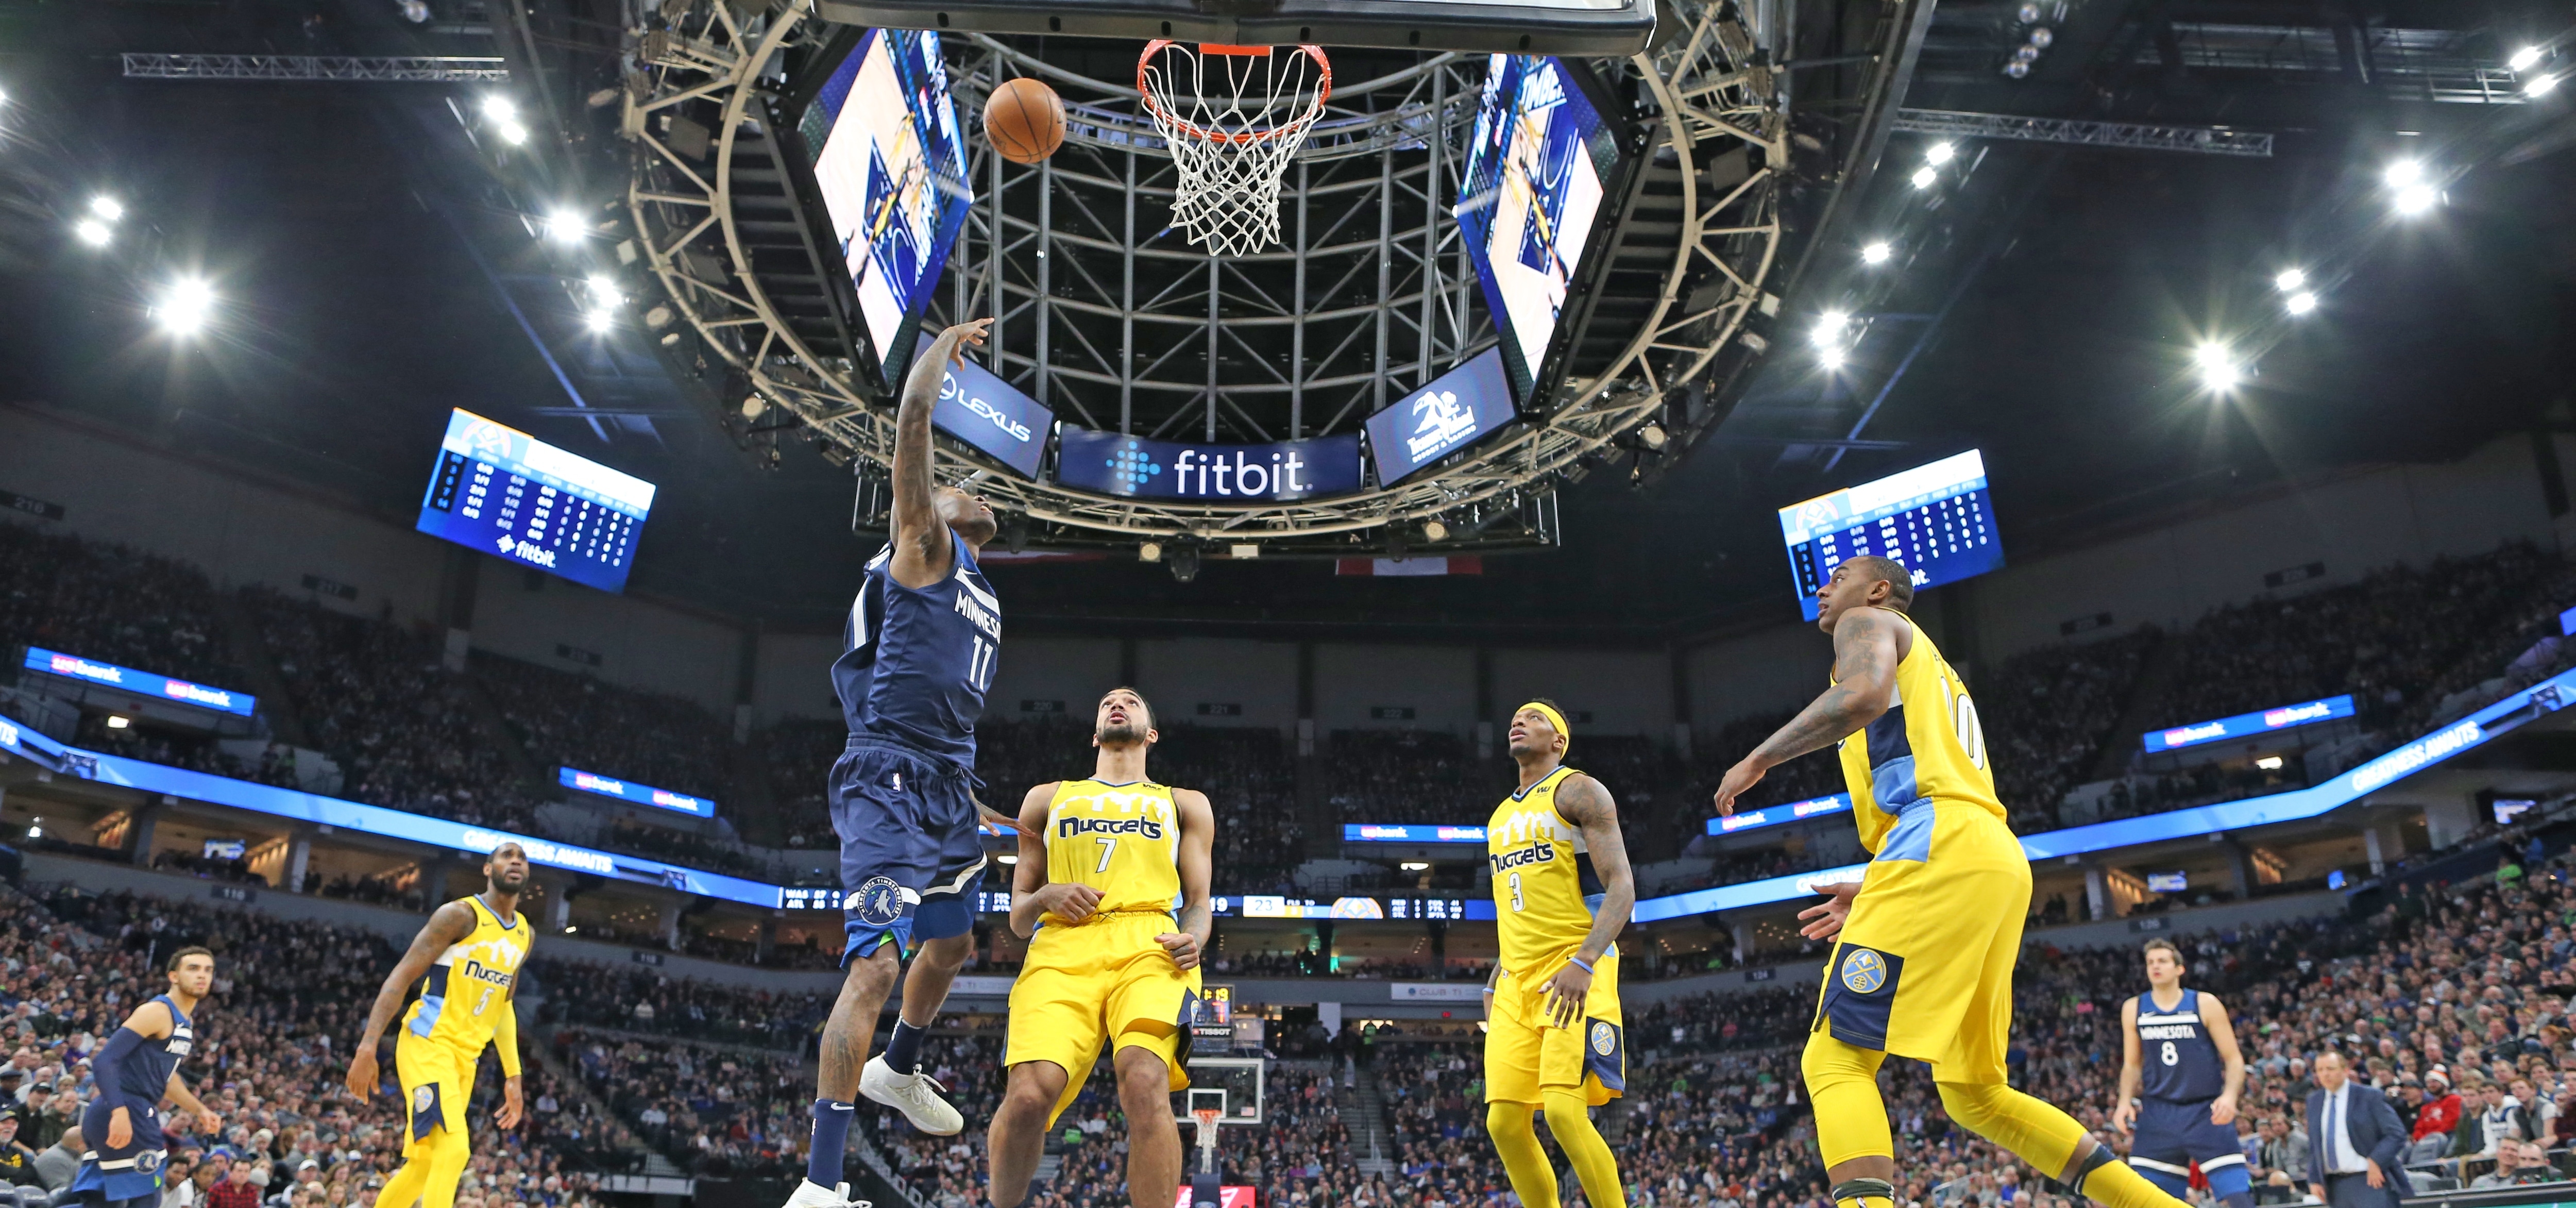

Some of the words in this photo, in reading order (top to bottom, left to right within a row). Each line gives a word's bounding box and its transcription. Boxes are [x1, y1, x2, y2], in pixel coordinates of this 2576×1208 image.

[958, 388, 1031, 443] LEXUS
[1174, 450, 1303, 495] fitbit
[515, 540, 556, 568] fitbit
[954, 589, 1001, 644] MINNESO
[970, 634, 993, 691] 11
[554, 848, 613, 873] AWAITS
[1095, 837, 1117, 874] 7
[786, 889, 809, 899] WAS
[786, 899, 805, 909] ATL
[859, 881, 875, 913] MINNESOTA
[877, 879, 902, 914] TIMBERWOLVES
[1255, 900, 1272, 911] 23
[1509, 871, 1525, 913] 3
[473, 986, 495, 1016] 5
[2139, 1025, 2196, 1040] MINNESOTA
[2161, 1041, 2179, 1066] 8
